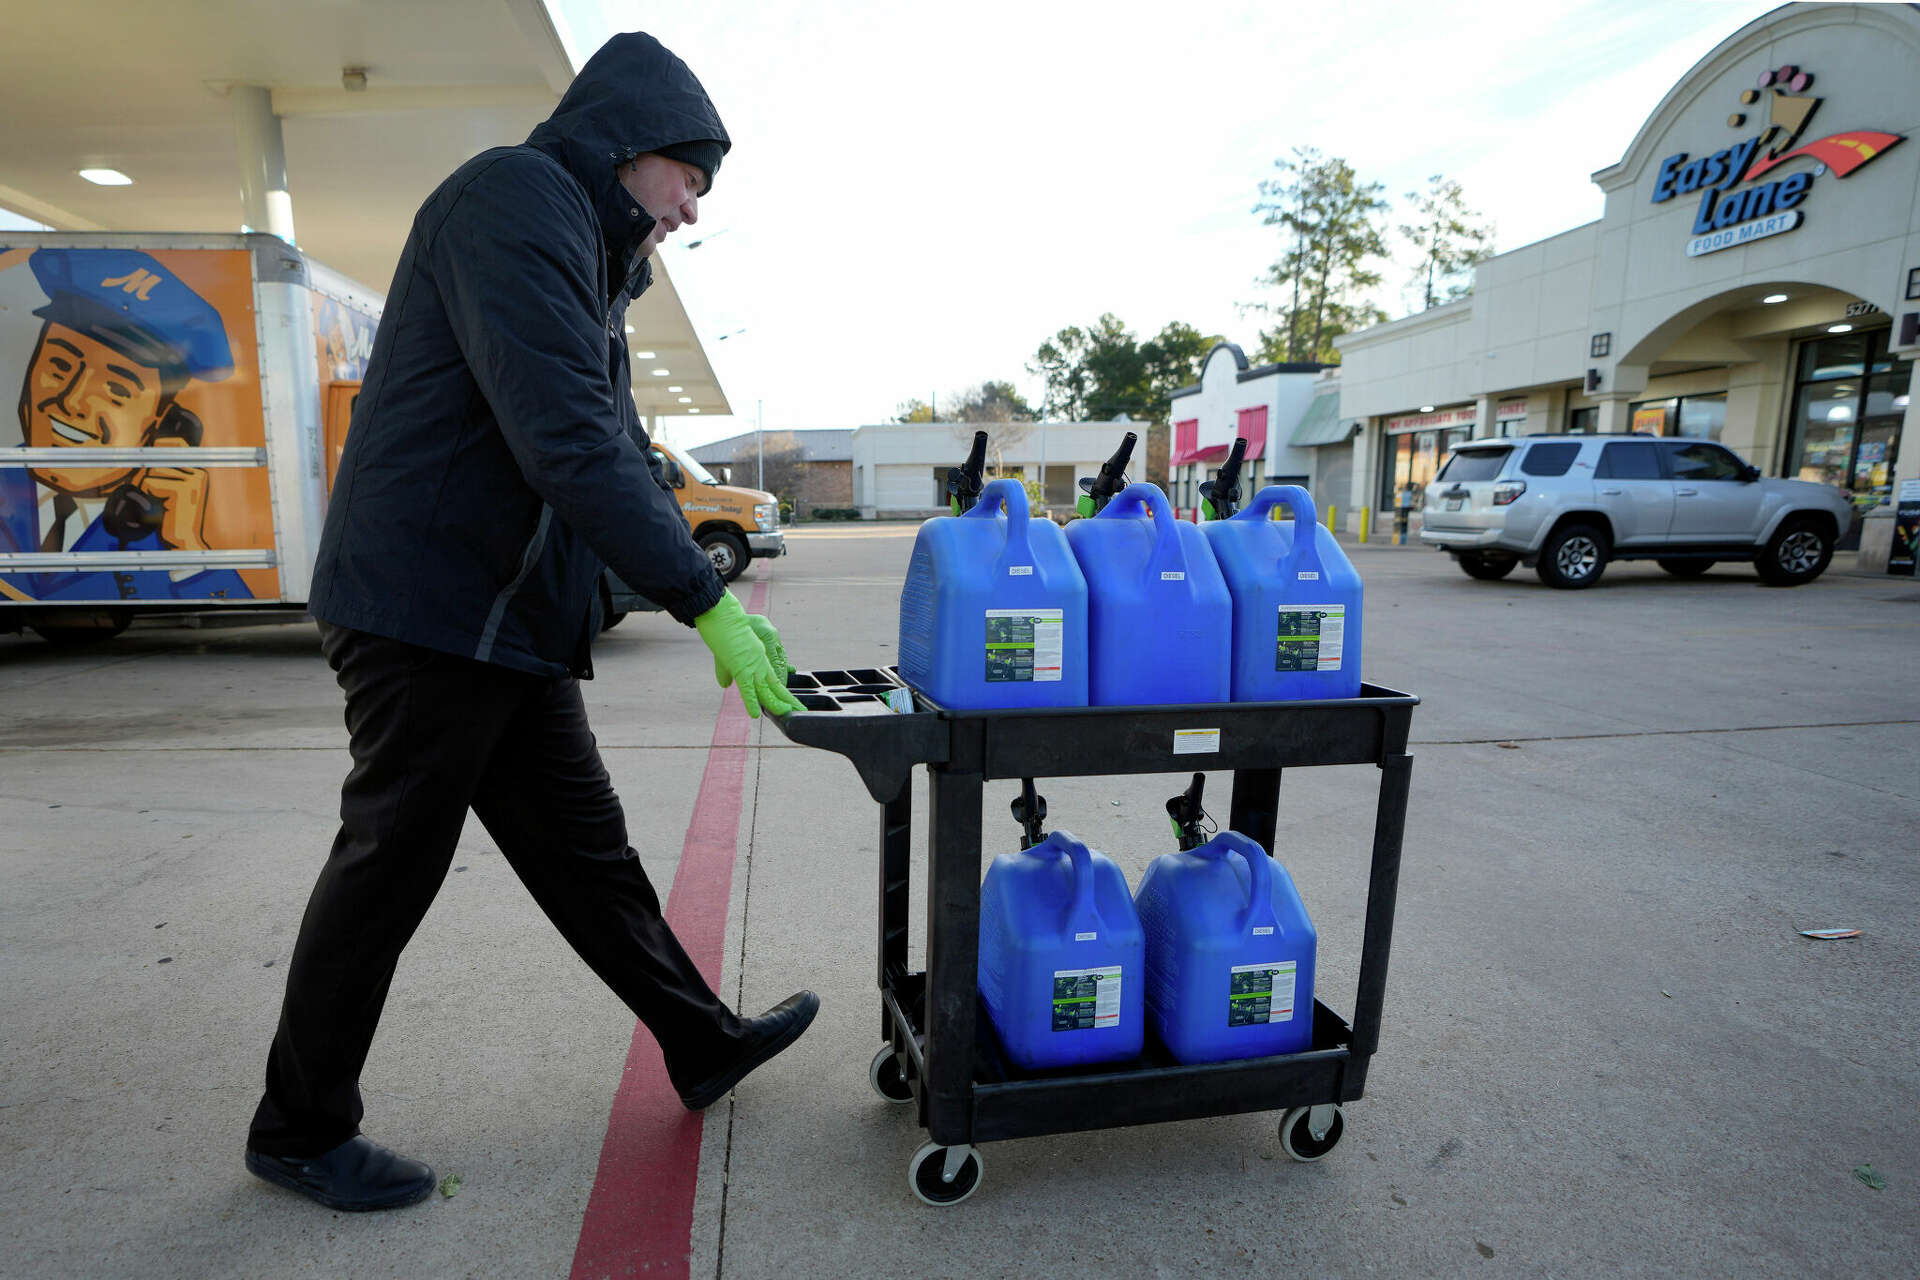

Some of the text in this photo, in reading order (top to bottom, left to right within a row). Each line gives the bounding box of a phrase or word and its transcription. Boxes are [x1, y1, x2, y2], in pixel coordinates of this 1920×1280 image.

[1651, 136, 1761, 204] Easy
[1692, 171, 1813, 235] Lane
[1693, 214, 1788, 253] FOOD MART
[101, 268, 162, 301] M
[1010, 567, 1032, 575] DIESEL
[1162, 572, 1184, 580] DIESEL
